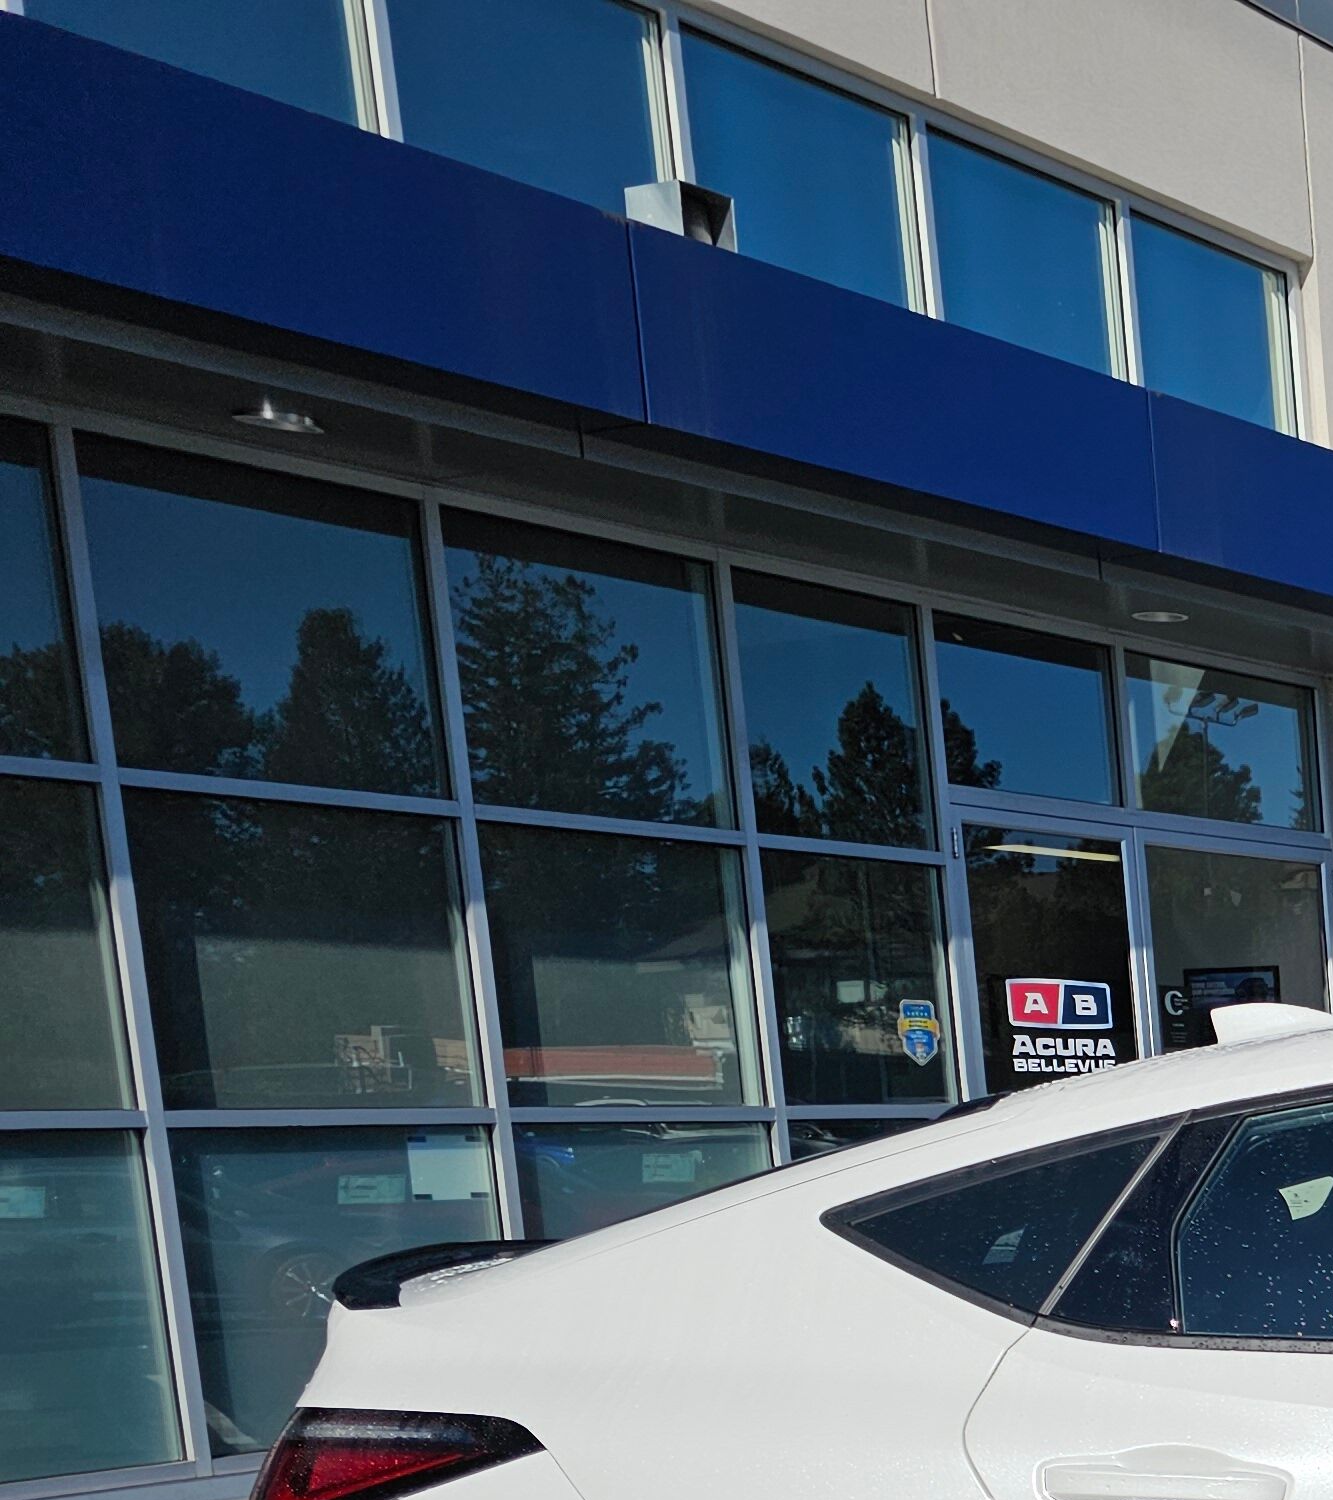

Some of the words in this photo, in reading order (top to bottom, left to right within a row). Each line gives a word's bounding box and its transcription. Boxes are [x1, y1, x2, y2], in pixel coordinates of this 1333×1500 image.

[1023, 992, 1049, 1014] A
[1072, 994, 1098, 1016] B
[1012, 1034, 1117, 1057] ACURA
[1012, 1058, 1117, 1073] BELLEVUE
